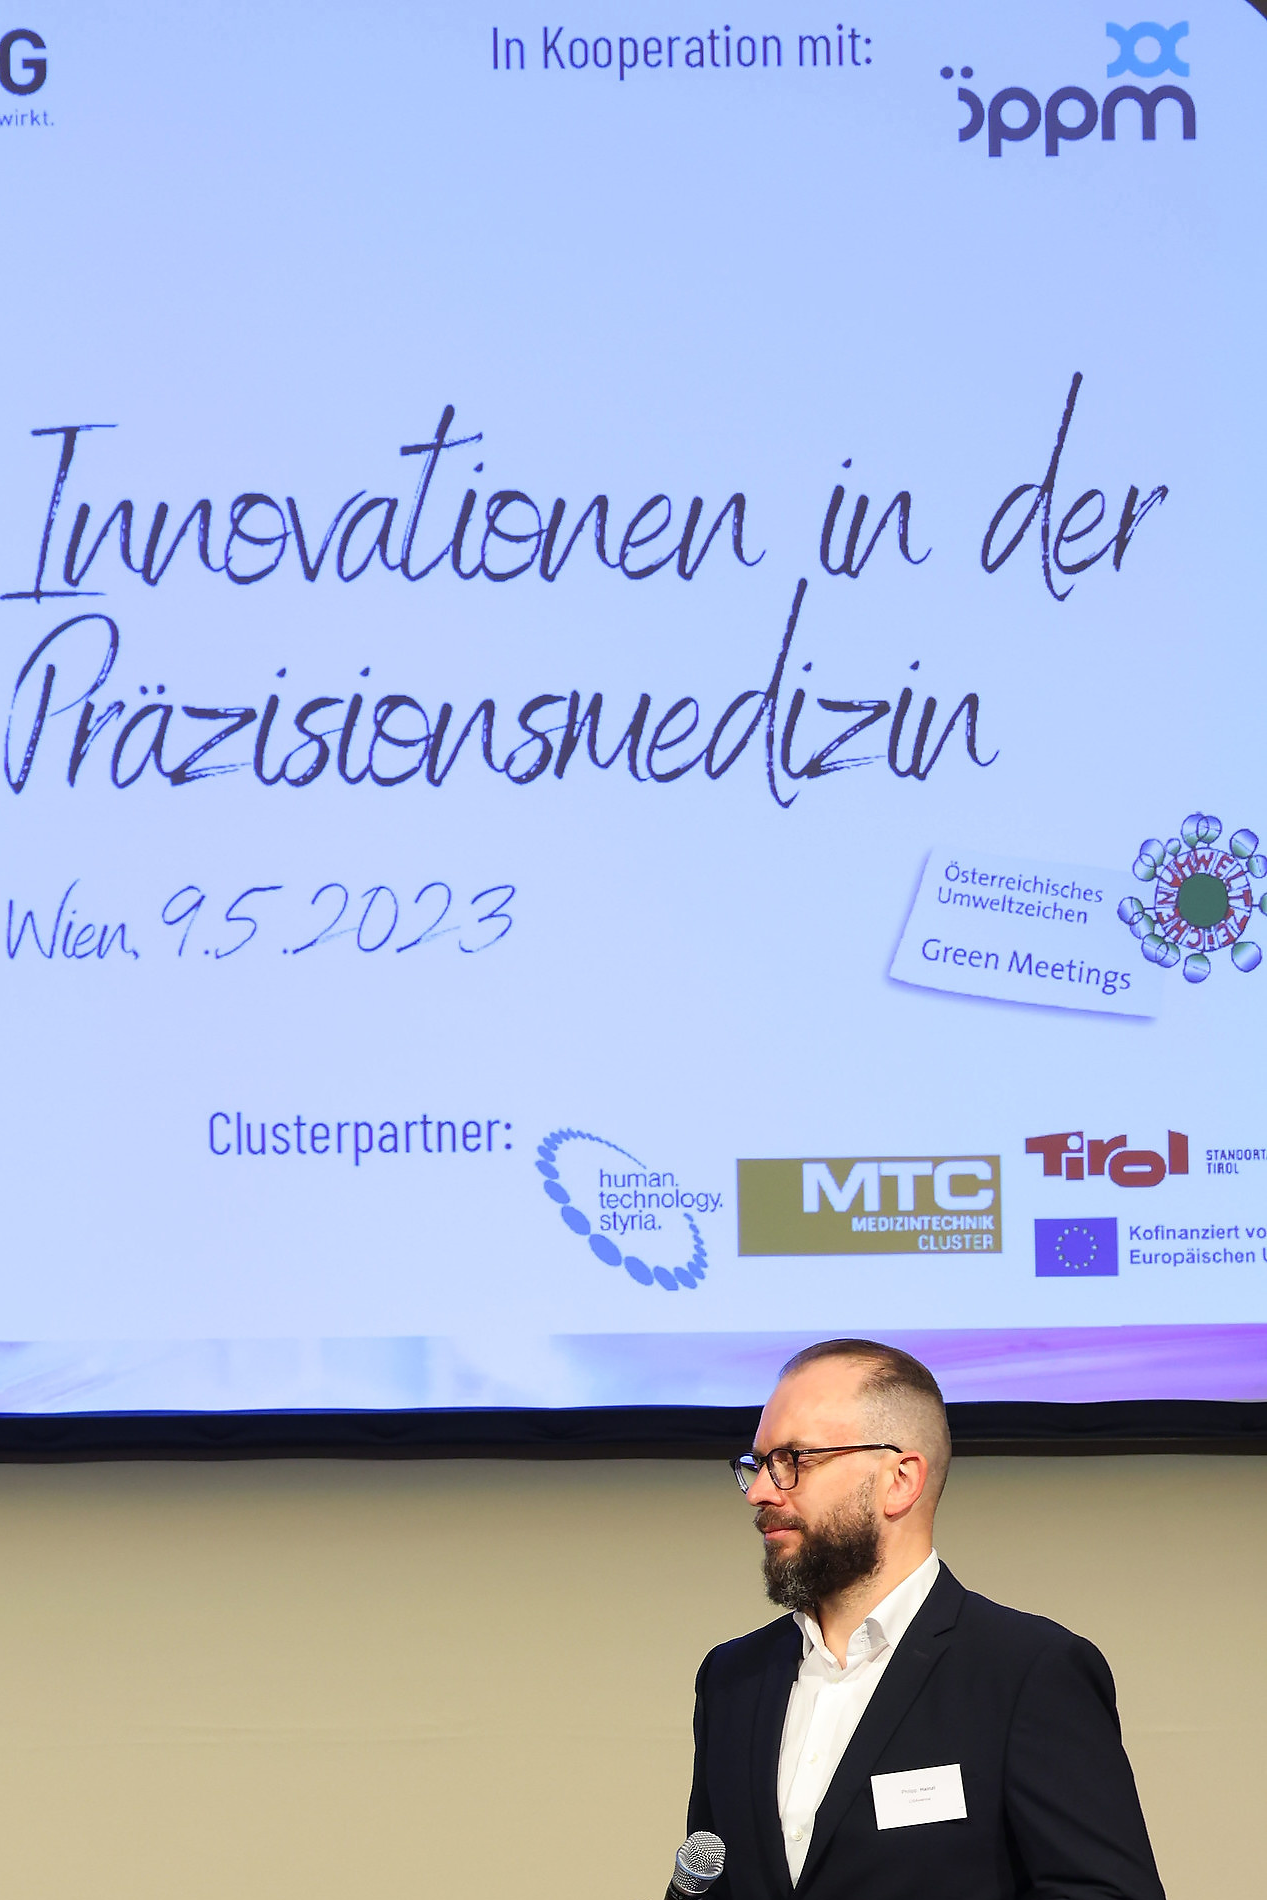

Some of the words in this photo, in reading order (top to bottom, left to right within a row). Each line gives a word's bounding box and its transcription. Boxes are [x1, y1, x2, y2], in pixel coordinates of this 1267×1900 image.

[493, 27, 524, 69] In
[544, 25, 781, 81] Kooperation
[799, 24, 872, 66] mit:
[0, 405, 765, 601] Innovationen
[819, 459, 931, 577] in
[983, 372, 1167, 600] der
[5, 578, 999, 807] Präzisionsmedizin
[944, 861, 1104, 904] Österreichisches
[938, 887, 1088, 925] Umweltzeichen
[921, 939, 999, 972] Green
[1008, 951, 1131, 995] Meetings
[209, 1112, 512, 1166] Clusterpartner:
[1025, 1130, 1189, 1188] Tirol
[1206, 1149, 1267, 1161] STANDORT
[1207, 1162, 1239, 1174] TIROL
[599, 1169, 679, 1188] human.
[803, 1161, 994, 1213] MTC
[599, 1190, 723, 1213] technology.
[600, 1211, 661, 1235] styria.
[852, 1216, 995, 1232] MEDIZINTECHNIK
[1129, 1225, 1239, 1240] Kofinanziert
[918, 1234, 994, 1251] CLUSTER
[1129, 1247, 1255, 1266] Europäischen
